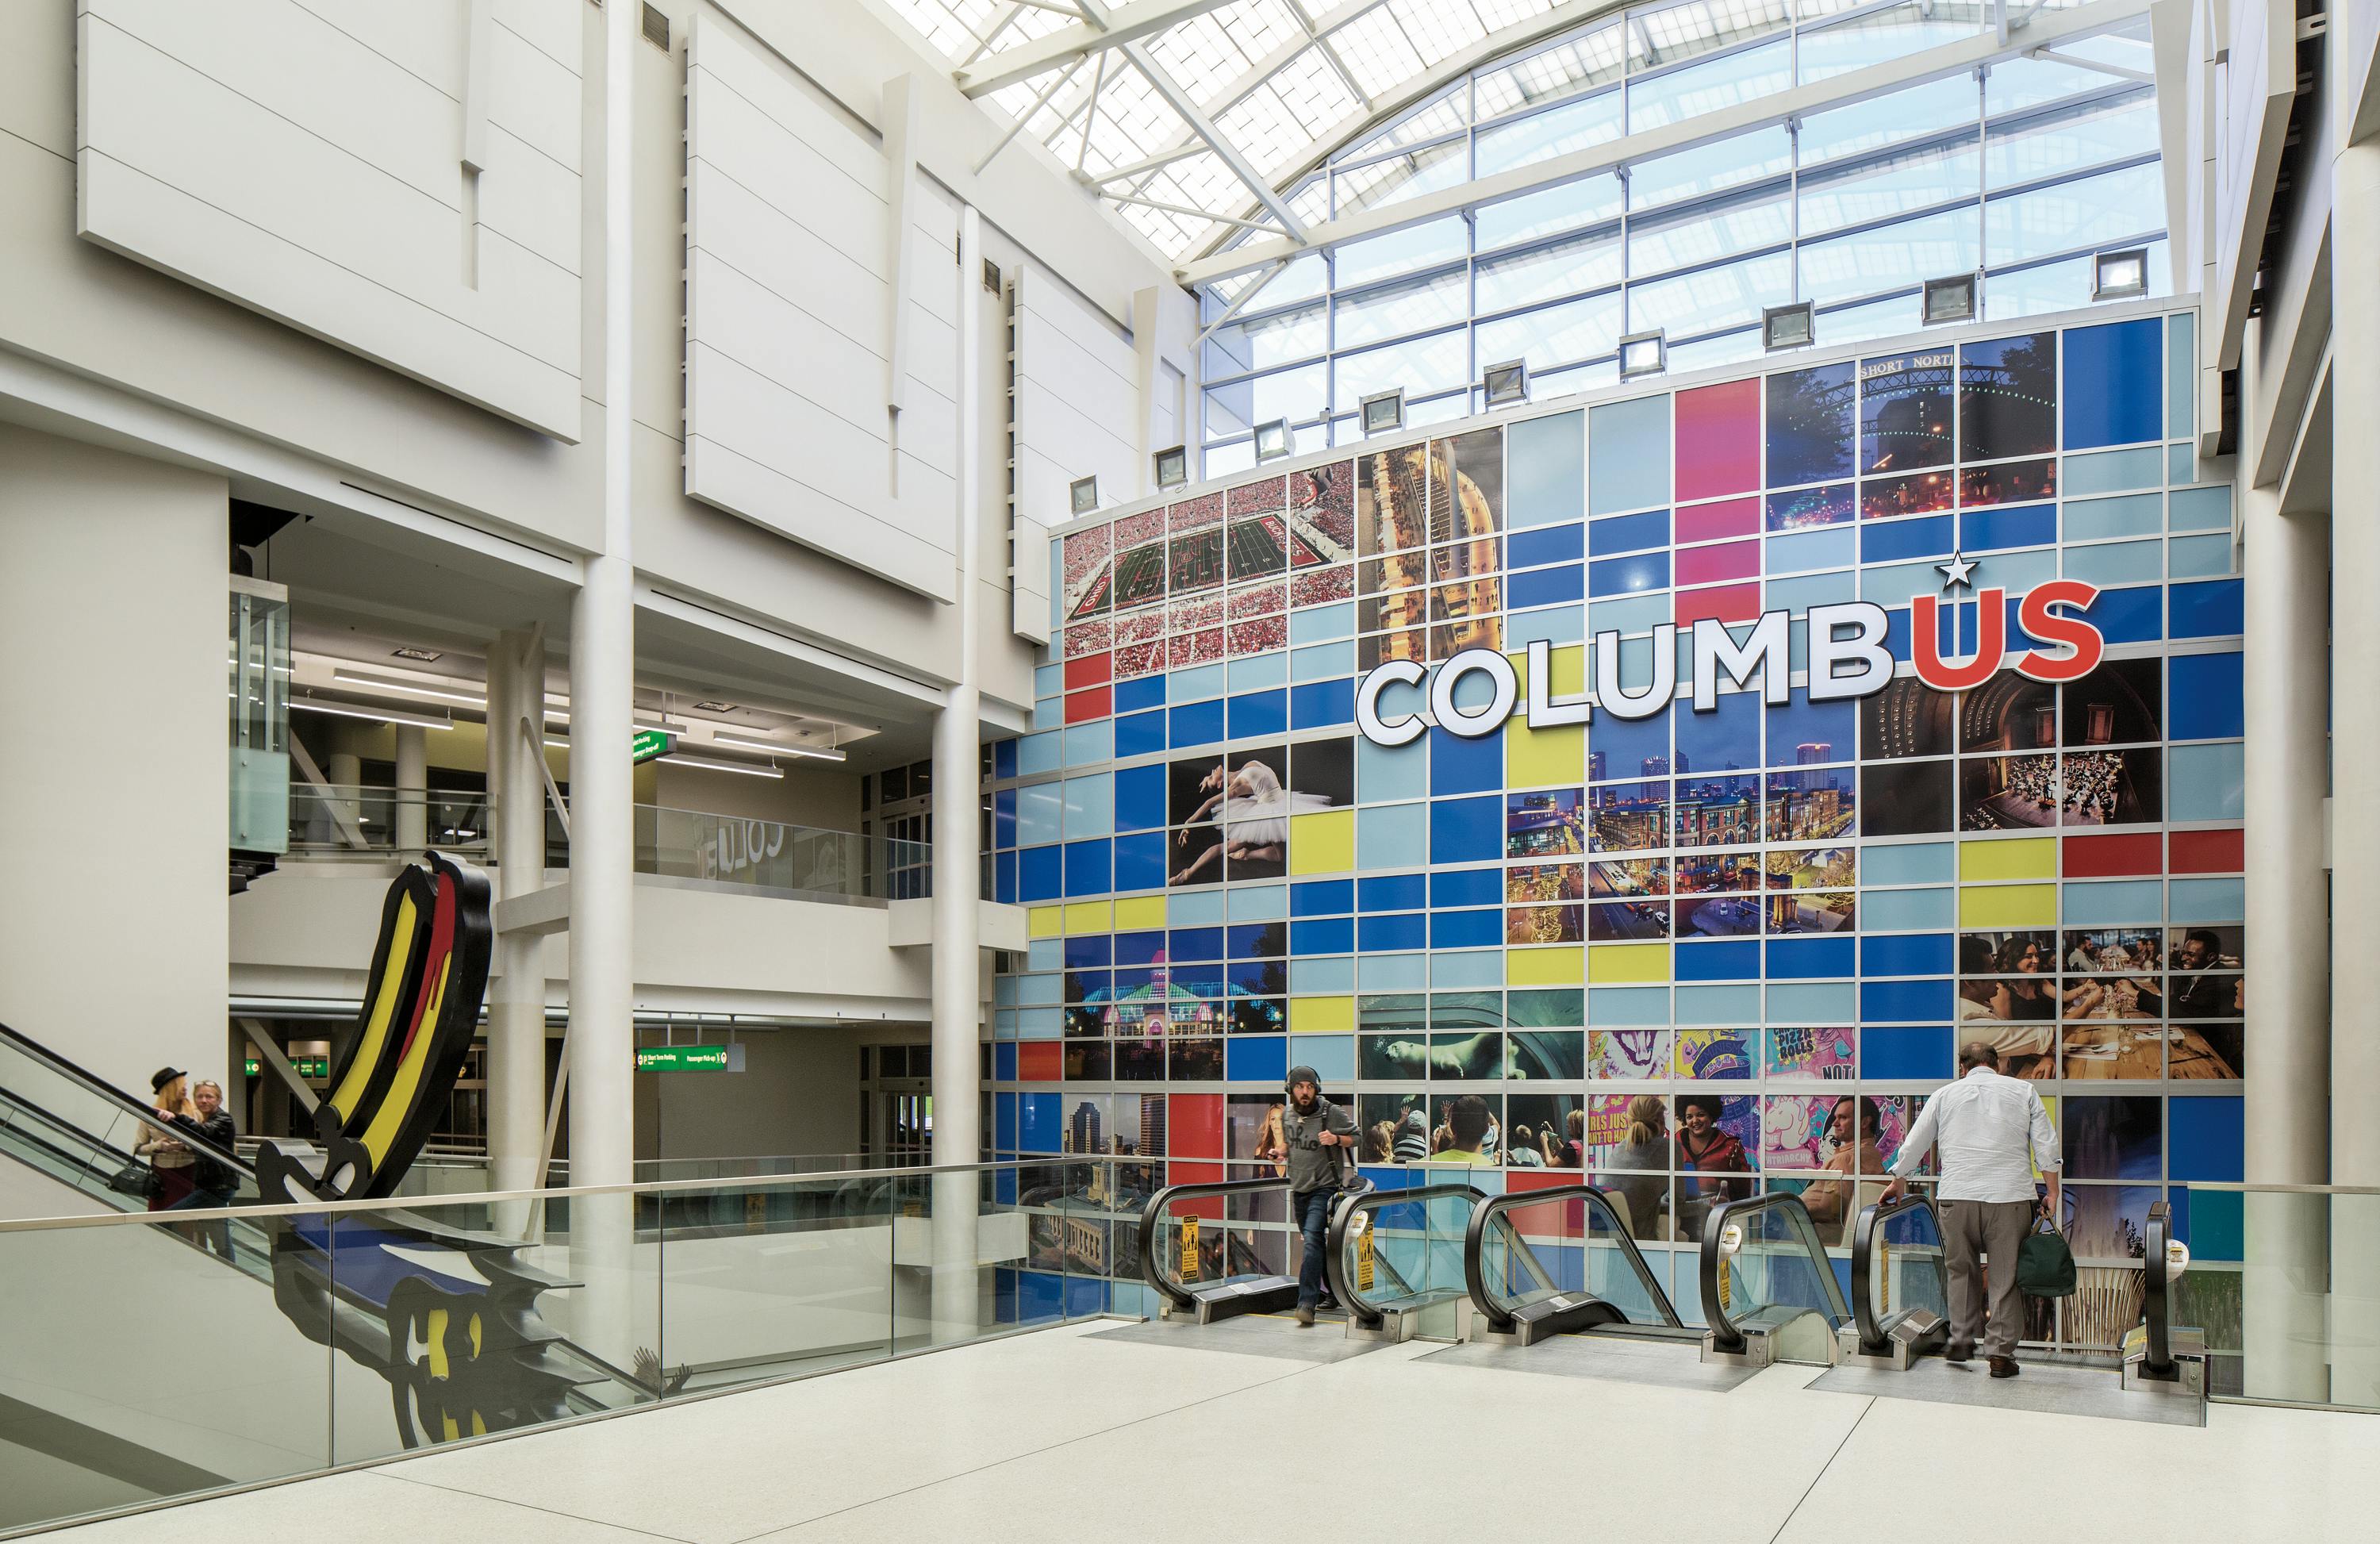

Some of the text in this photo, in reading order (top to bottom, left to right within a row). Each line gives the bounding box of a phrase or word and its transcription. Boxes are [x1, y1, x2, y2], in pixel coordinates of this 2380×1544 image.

[1860, 359, 1904, 378] SHORT
[1084, 581, 1107, 607] OHIO
[1355, 578, 2104, 747] COLUMBUS
[1779, 1028, 1811, 1047] PIZZA
[703, 1054, 716, 1063] Pick-up
[1779, 1040, 1814, 1058] ROLLS
[1589, 1112, 1626, 1131] RLS JUS
[1286, 1124, 1319, 1151] Ohio
[1588, 1129, 1628, 1144] ANT TO HAV
[1766, 1153, 1812, 1166] ATRIARCHY
